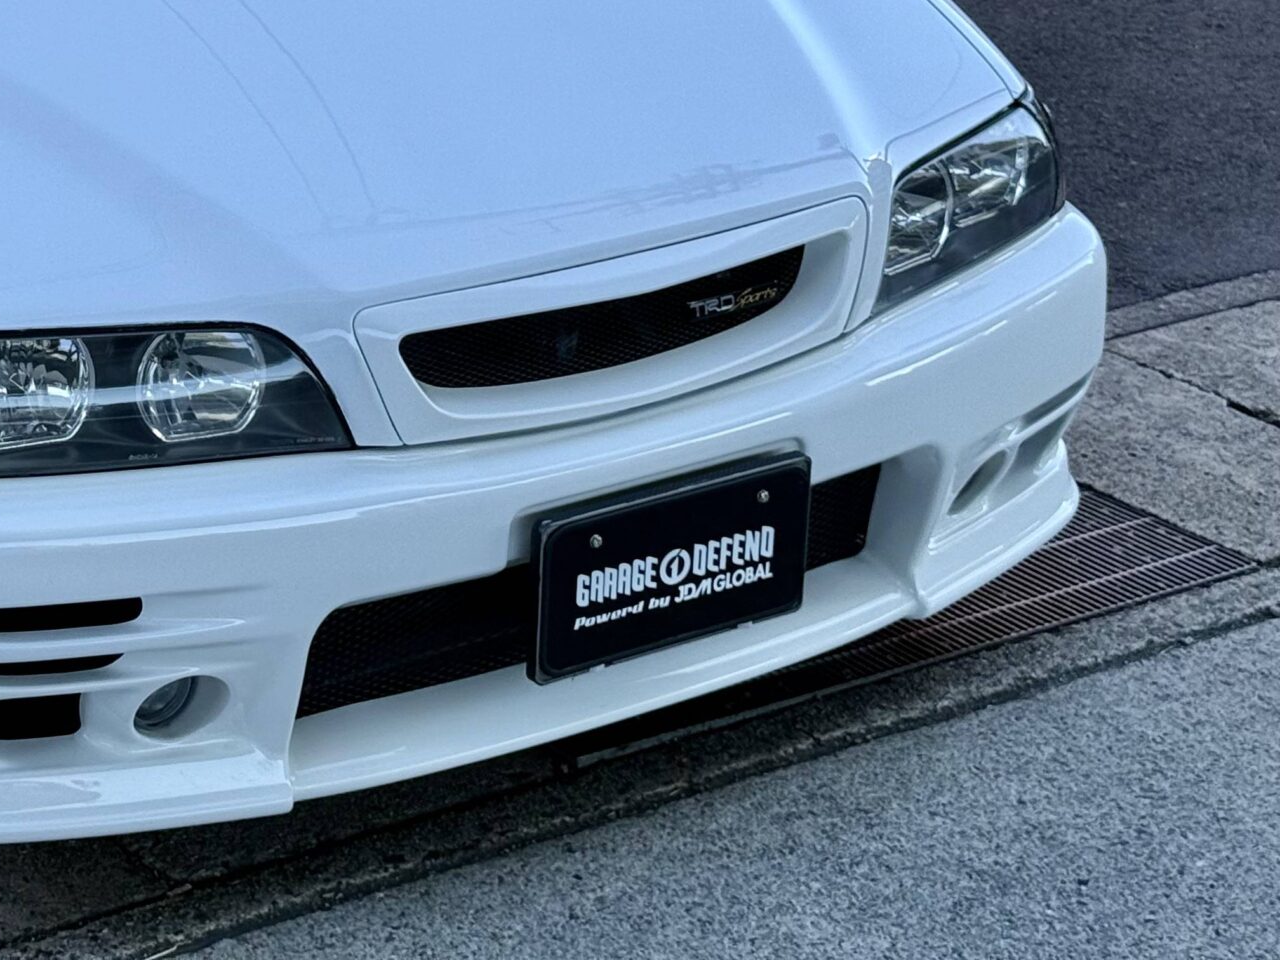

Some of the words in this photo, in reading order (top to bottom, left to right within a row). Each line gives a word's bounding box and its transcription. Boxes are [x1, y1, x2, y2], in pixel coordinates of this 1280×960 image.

[687, 294, 735, 317] TRD
[575, 556, 658, 607] GARAGE
[692, 525, 775, 577] DEFEND
[648, 596, 671, 610] by
[674, 578, 712, 603] JDM
[713, 561, 774, 592] GLOBAL
